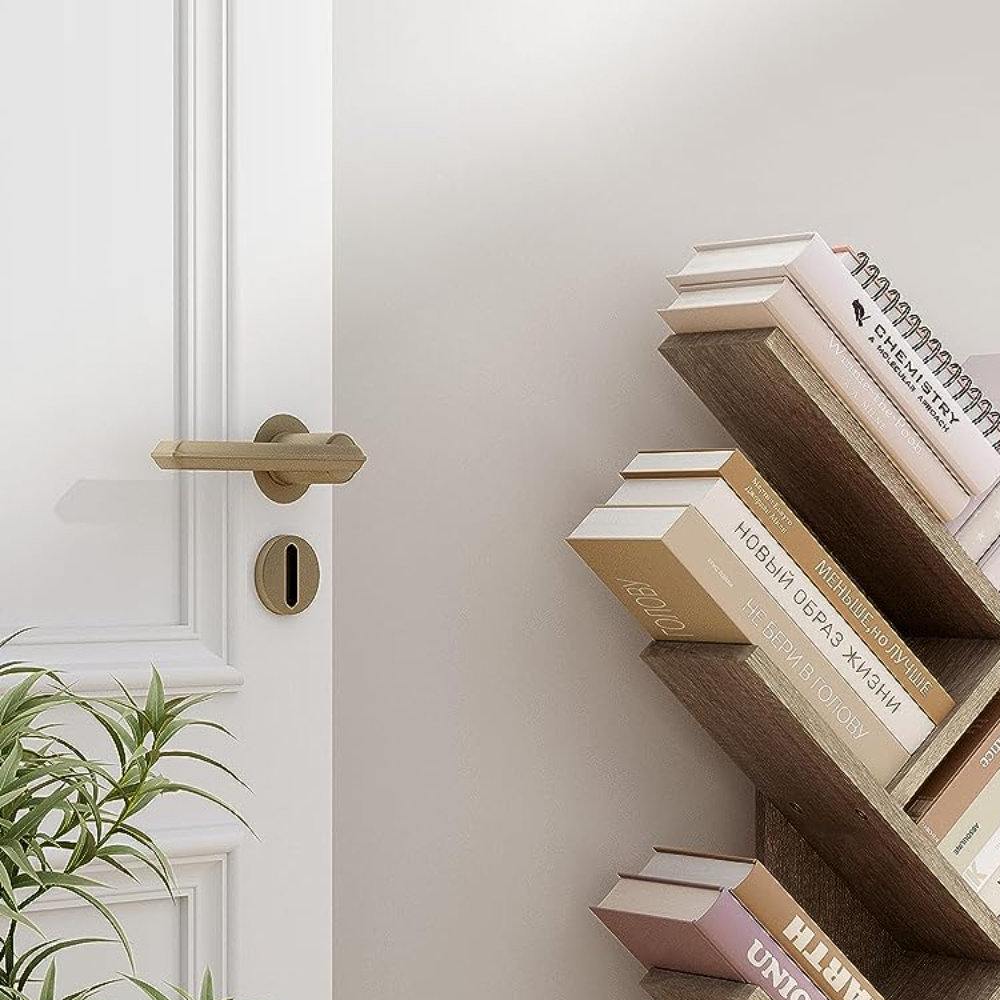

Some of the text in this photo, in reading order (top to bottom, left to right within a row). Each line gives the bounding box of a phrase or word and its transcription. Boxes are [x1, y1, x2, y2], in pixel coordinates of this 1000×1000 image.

[867, 335, 875, 344] A
[875, 344, 916, 393] MOLECULAR
[871, 323, 960, 427] CHEMISTRY
[732, 520, 903, 715] НОВЫЙ ОБРАЗ ЖИЗНИ
[884, 642, 933, 697] ЛУЧШЕ
[741, 598, 869, 743] НЕ БЕРИ В ГОЛОВУ
